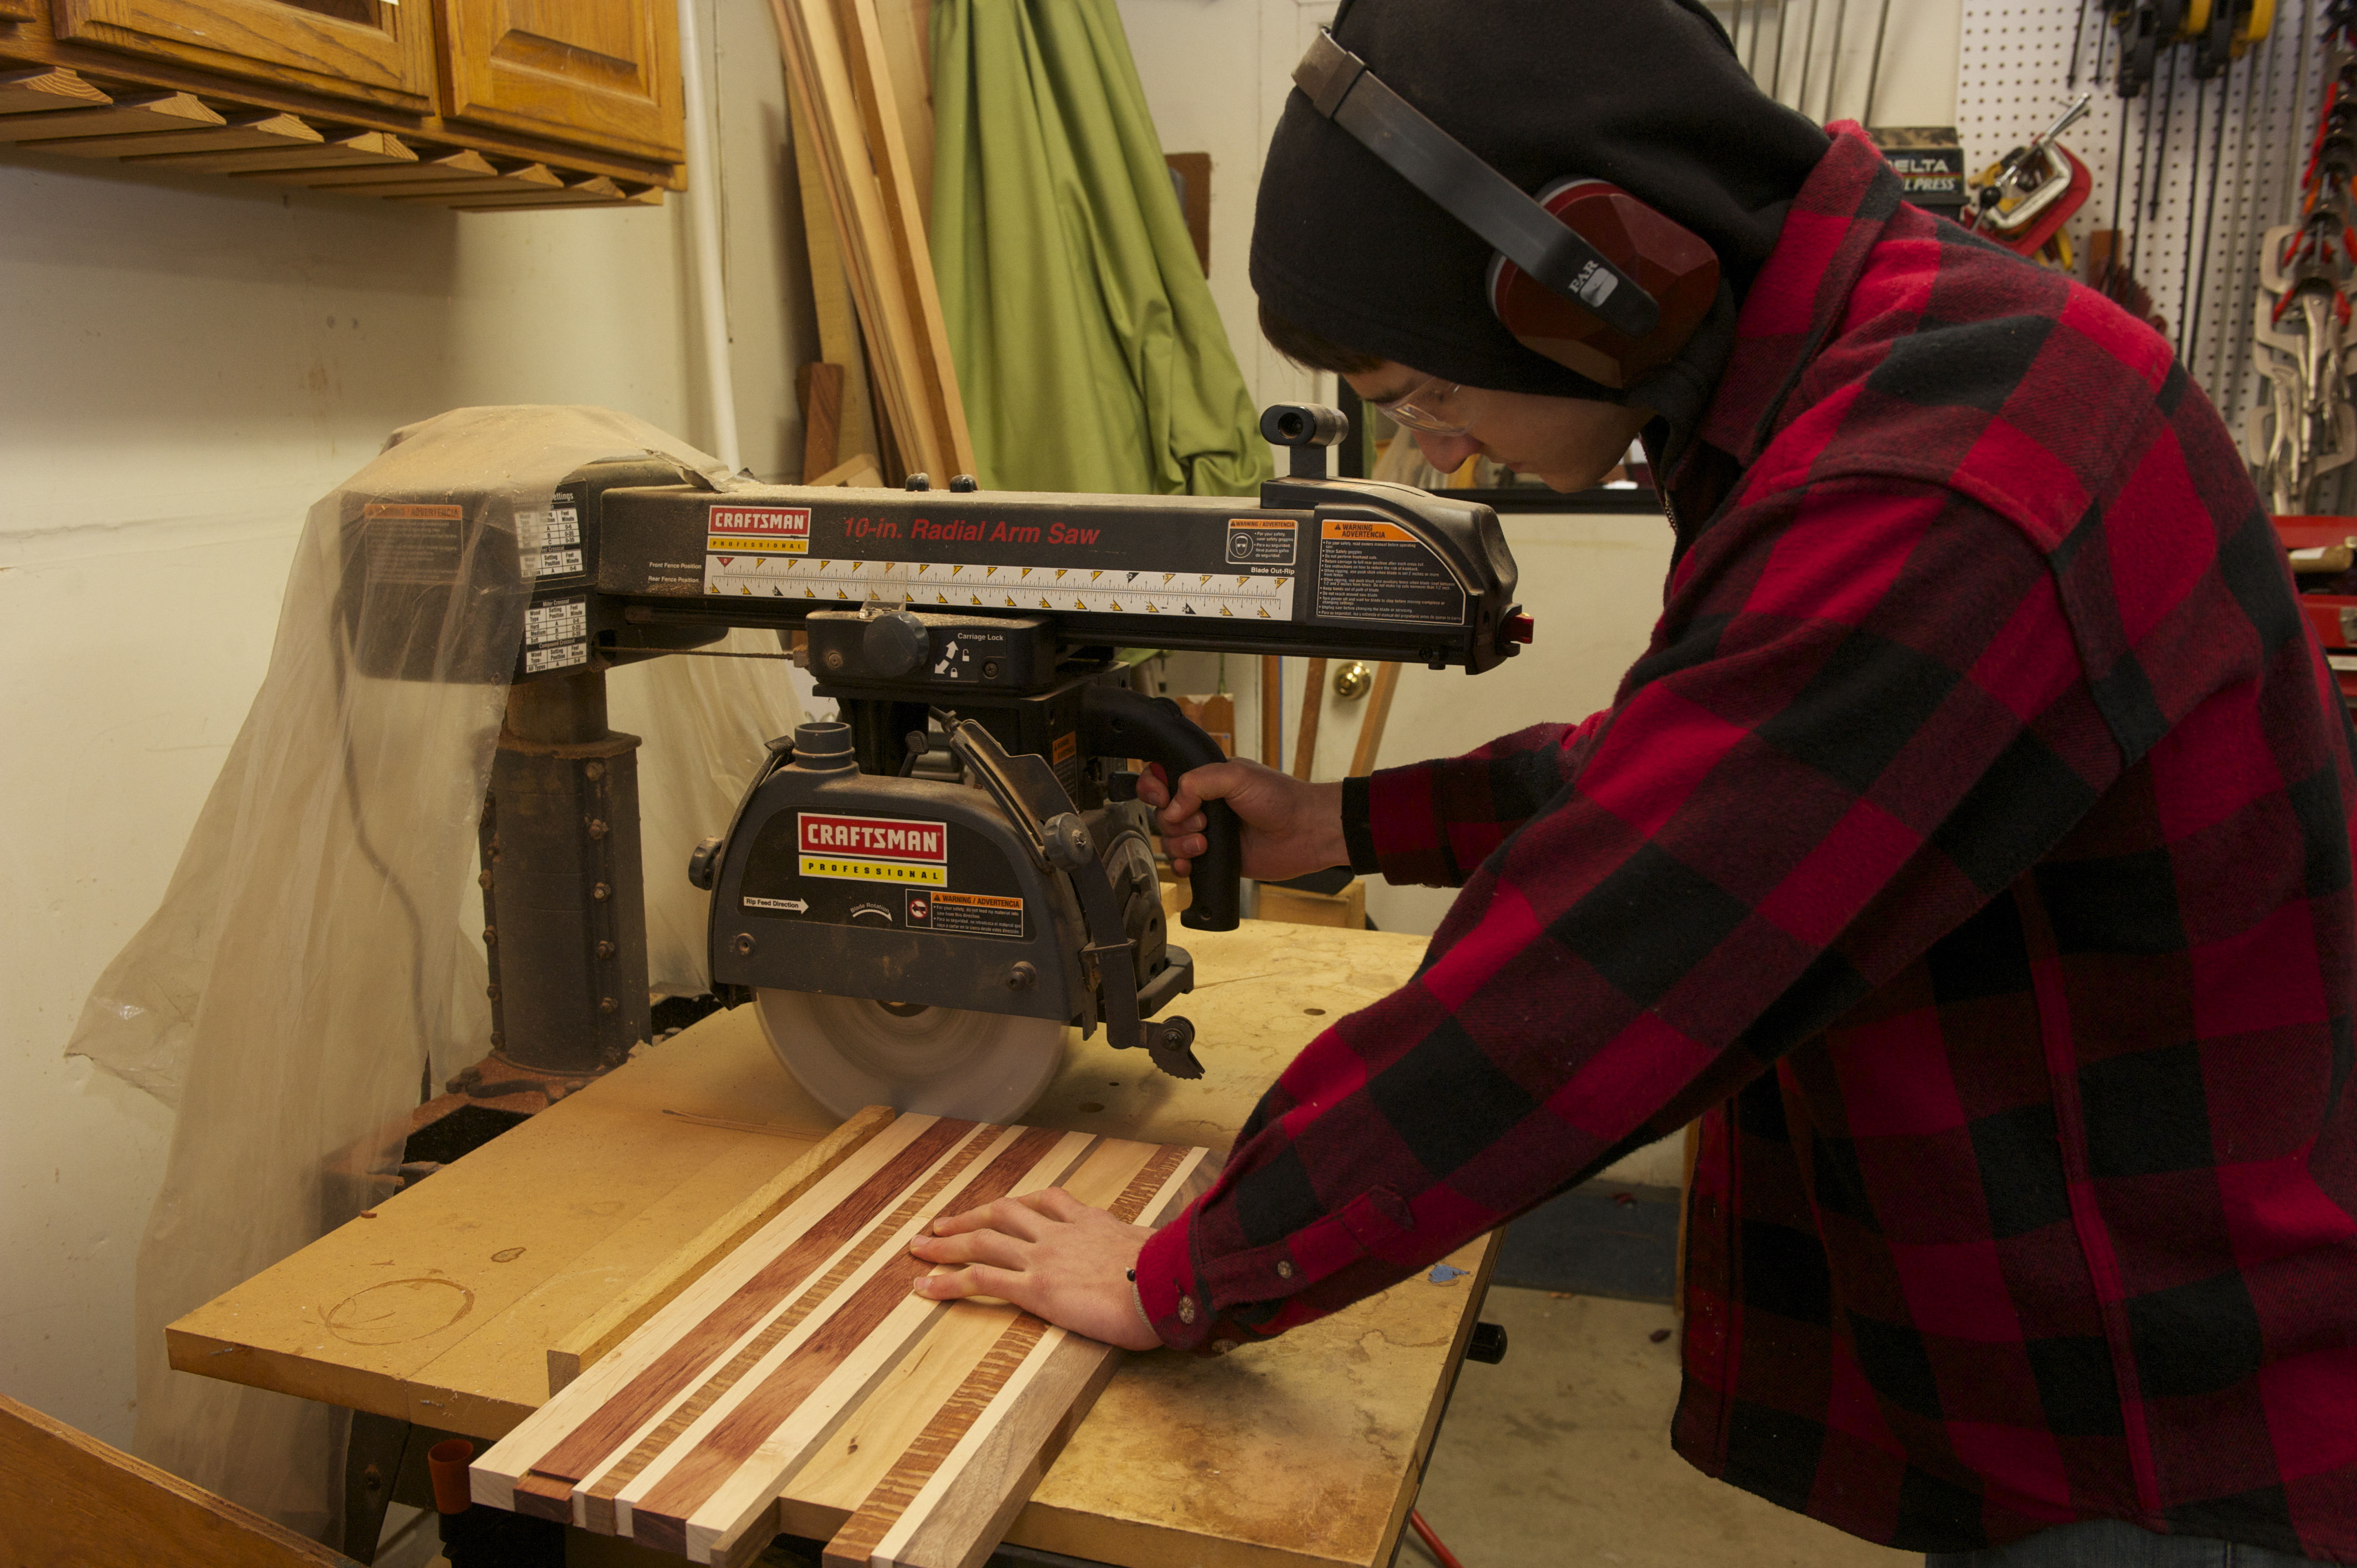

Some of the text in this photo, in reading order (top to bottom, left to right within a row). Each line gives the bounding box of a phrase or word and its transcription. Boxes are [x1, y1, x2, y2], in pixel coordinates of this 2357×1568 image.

[1913, 178, 1955, 191] PRESS
[1568, 260, 1599, 293] EAR
[553, 492, 574, 501] ettings
[715, 513, 804, 529] CRAFTSMAN
[845, 518, 1100, 545] 10-in. Radial Arm Saw
[713, 541, 801, 549] PROFESSIONAL
[958, 633, 986, 641] Carriage
[807, 824, 937, 852] CRAFTSMAN
[809, 863, 938, 879] PROFESSIONAL
[850, 902, 889, 912] Blade Rotation
[943, 895, 971, 904] WARNING
[977, 898, 1020, 907] ADVERTENCIA
